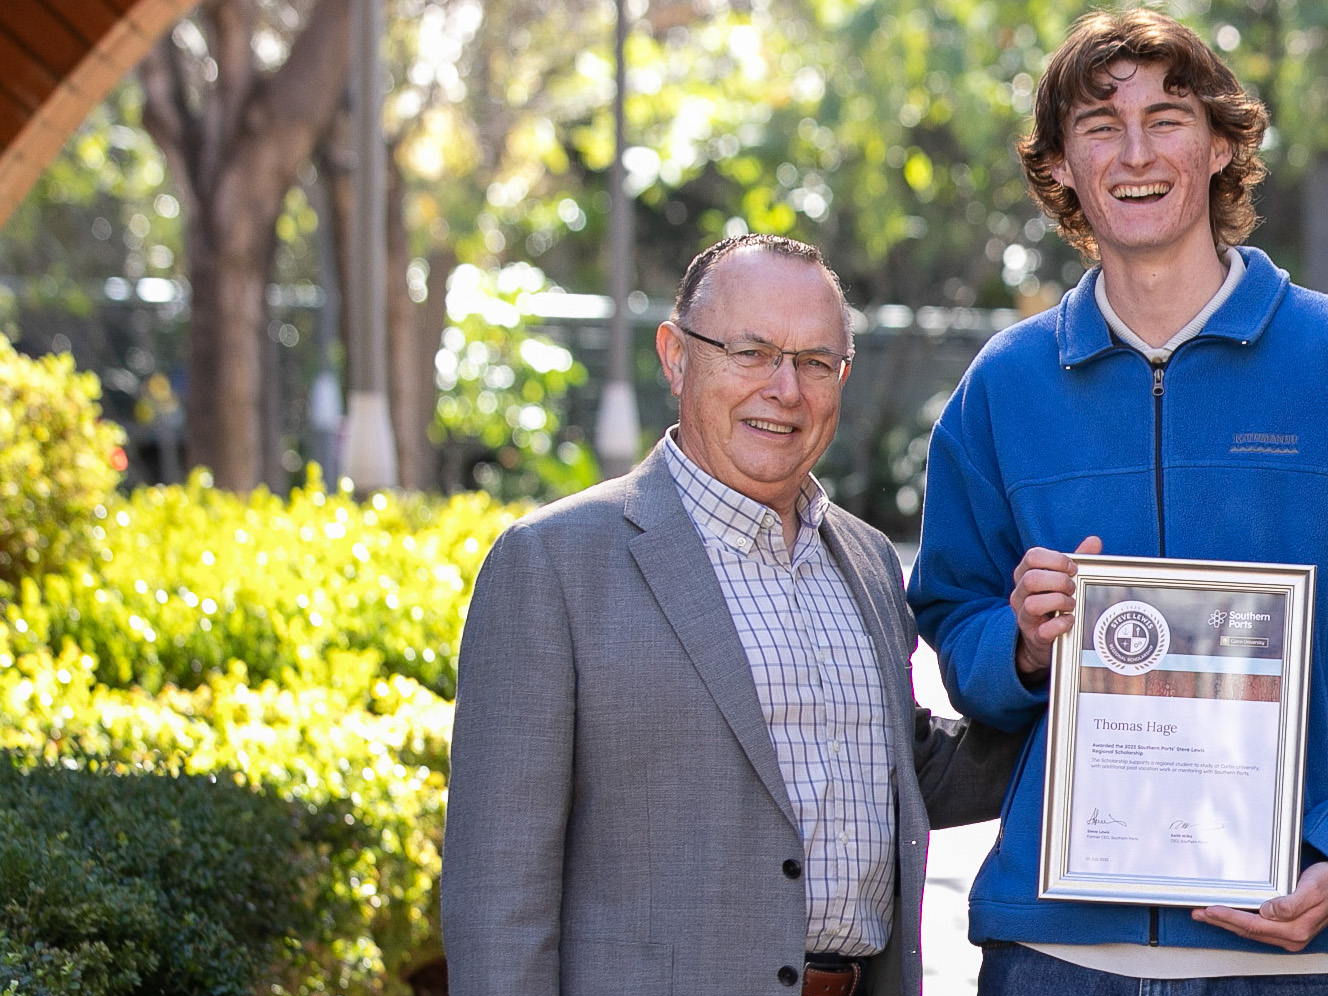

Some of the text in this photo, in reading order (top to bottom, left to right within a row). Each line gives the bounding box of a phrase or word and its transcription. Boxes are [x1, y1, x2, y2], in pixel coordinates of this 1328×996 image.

[1110, 613, 1154, 630] STEVE LEWIS
[1228, 620, 1252, 628] Ports
[1229, 611, 1270, 621] Southern
[1109, 643, 1154, 662] REGIONAL SCHOLARSHIP
[1093, 718, 1178, 736] Thomas Hage
